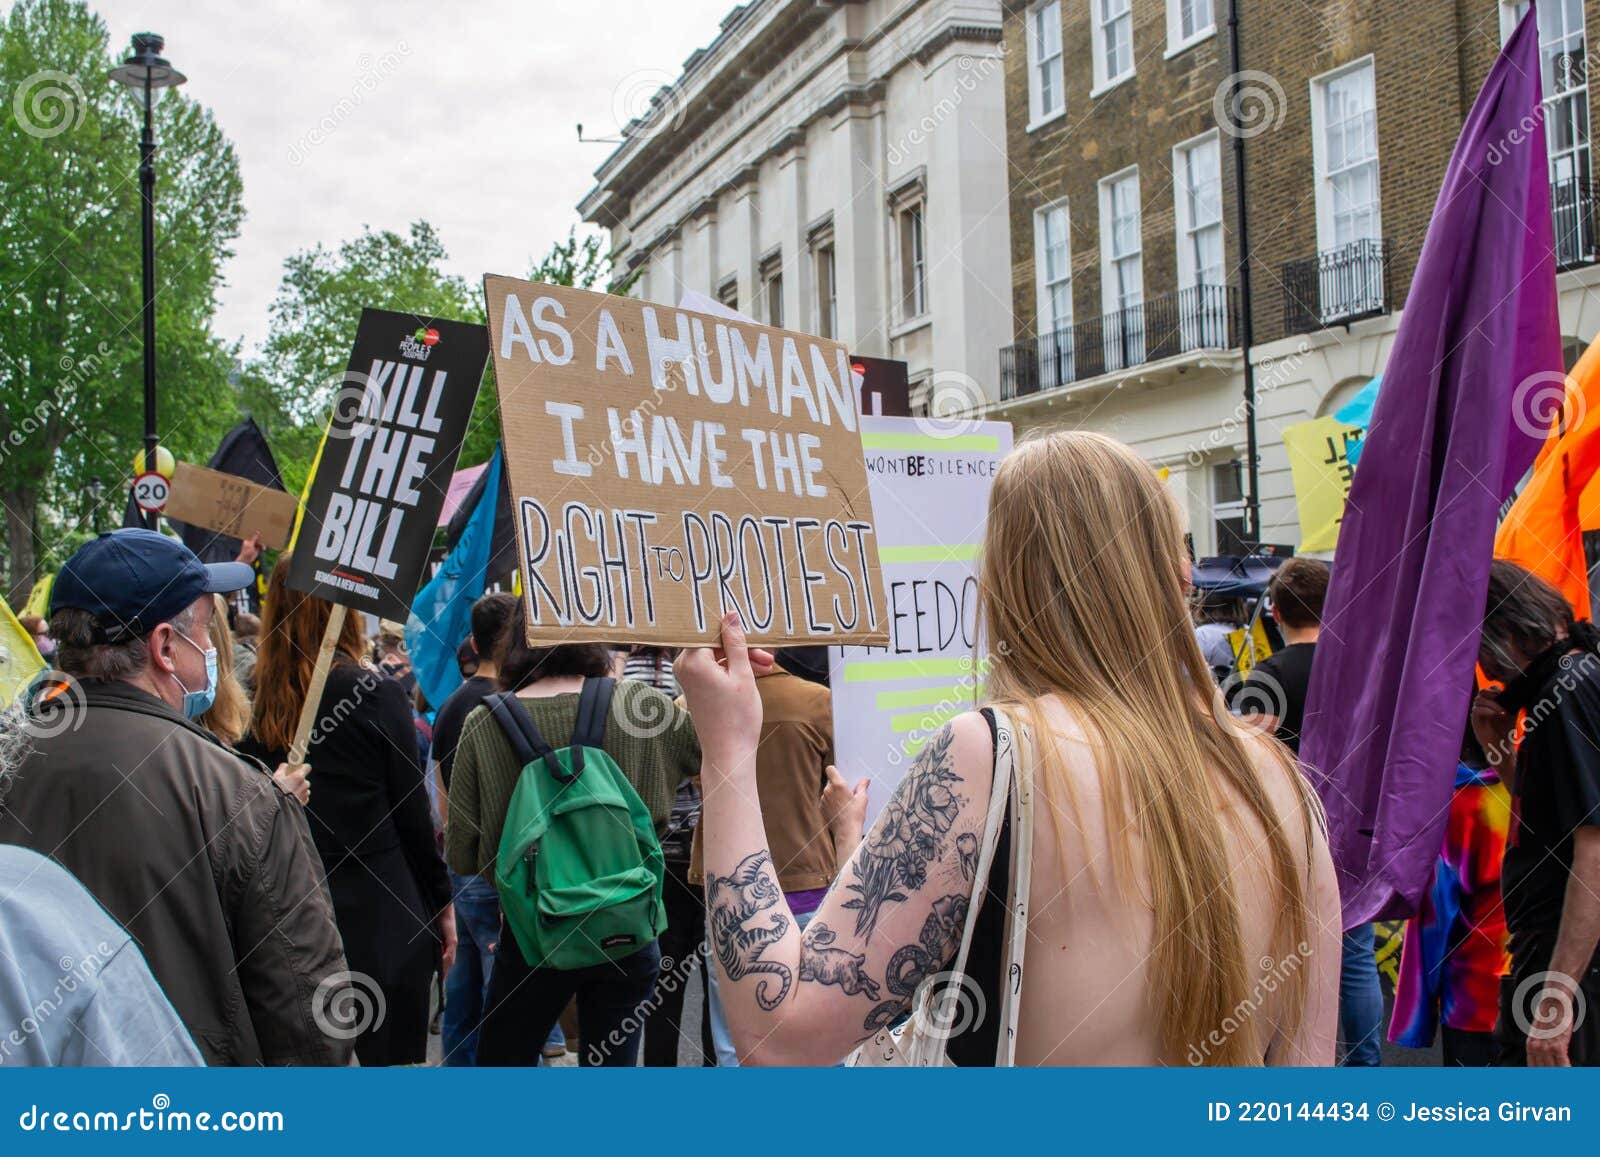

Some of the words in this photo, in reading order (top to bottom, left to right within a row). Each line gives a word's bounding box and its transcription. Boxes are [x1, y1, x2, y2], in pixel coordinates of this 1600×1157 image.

[357, 359, 448, 433] KILL
[501, 293, 574, 366] AS
[596, 308, 632, 375] A
[642, 306, 856, 433] HUMAN
[137, 483, 167, 500] 20
[340, 422, 436, 506] THE
[545, 401, 592, 477] I
[607, 407, 734, 488] HAVE
[742, 428, 828, 497] THE
[314, 492, 405, 580] BILL
[649, 546, 684, 582] TO
[682, 511, 878, 635] PROTEST
